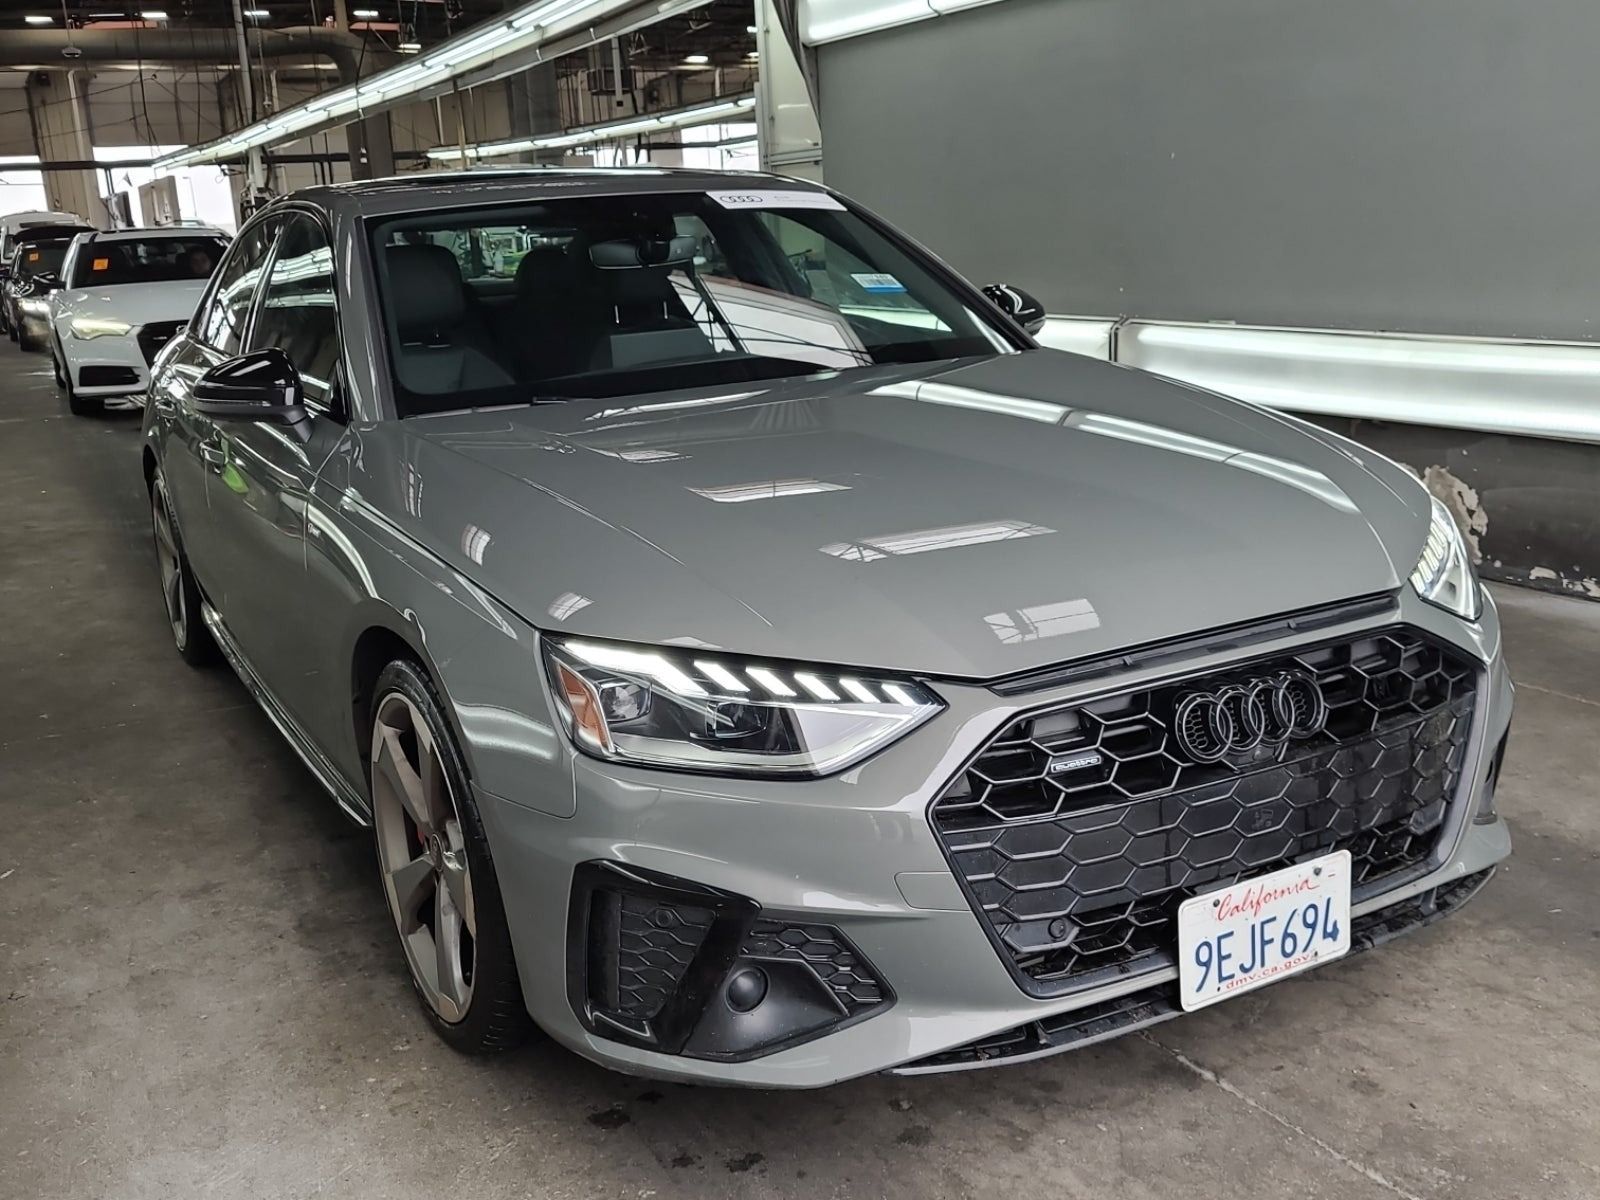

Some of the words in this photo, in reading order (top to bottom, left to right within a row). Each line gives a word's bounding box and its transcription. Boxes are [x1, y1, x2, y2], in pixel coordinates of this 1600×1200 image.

[1216, 877, 1320, 921] California
[1195, 897, 1340, 993] 9EJF694
[1225, 954, 1311, 990] dmv.ca.gov
